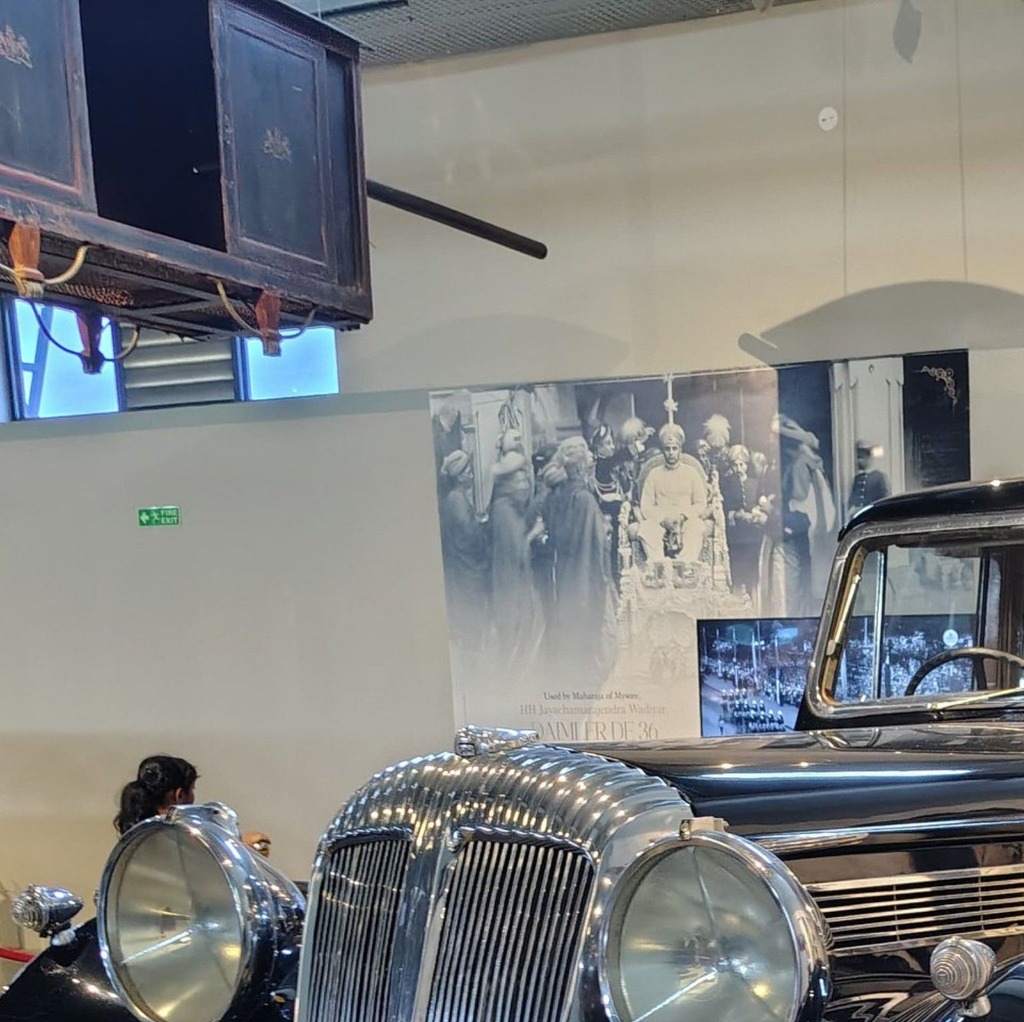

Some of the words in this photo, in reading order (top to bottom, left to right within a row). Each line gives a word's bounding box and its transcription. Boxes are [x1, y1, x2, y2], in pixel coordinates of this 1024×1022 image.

[544, 692, 561, 700] Used
[562, 692, 571, 701] by
[606, 691, 613, 699] of
[520, 704, 536, 715] HH
[532, 721, 606, 740] DAIMLER
[611, 721, 634, 740] DE
[638, 721, 658, 740] 36
